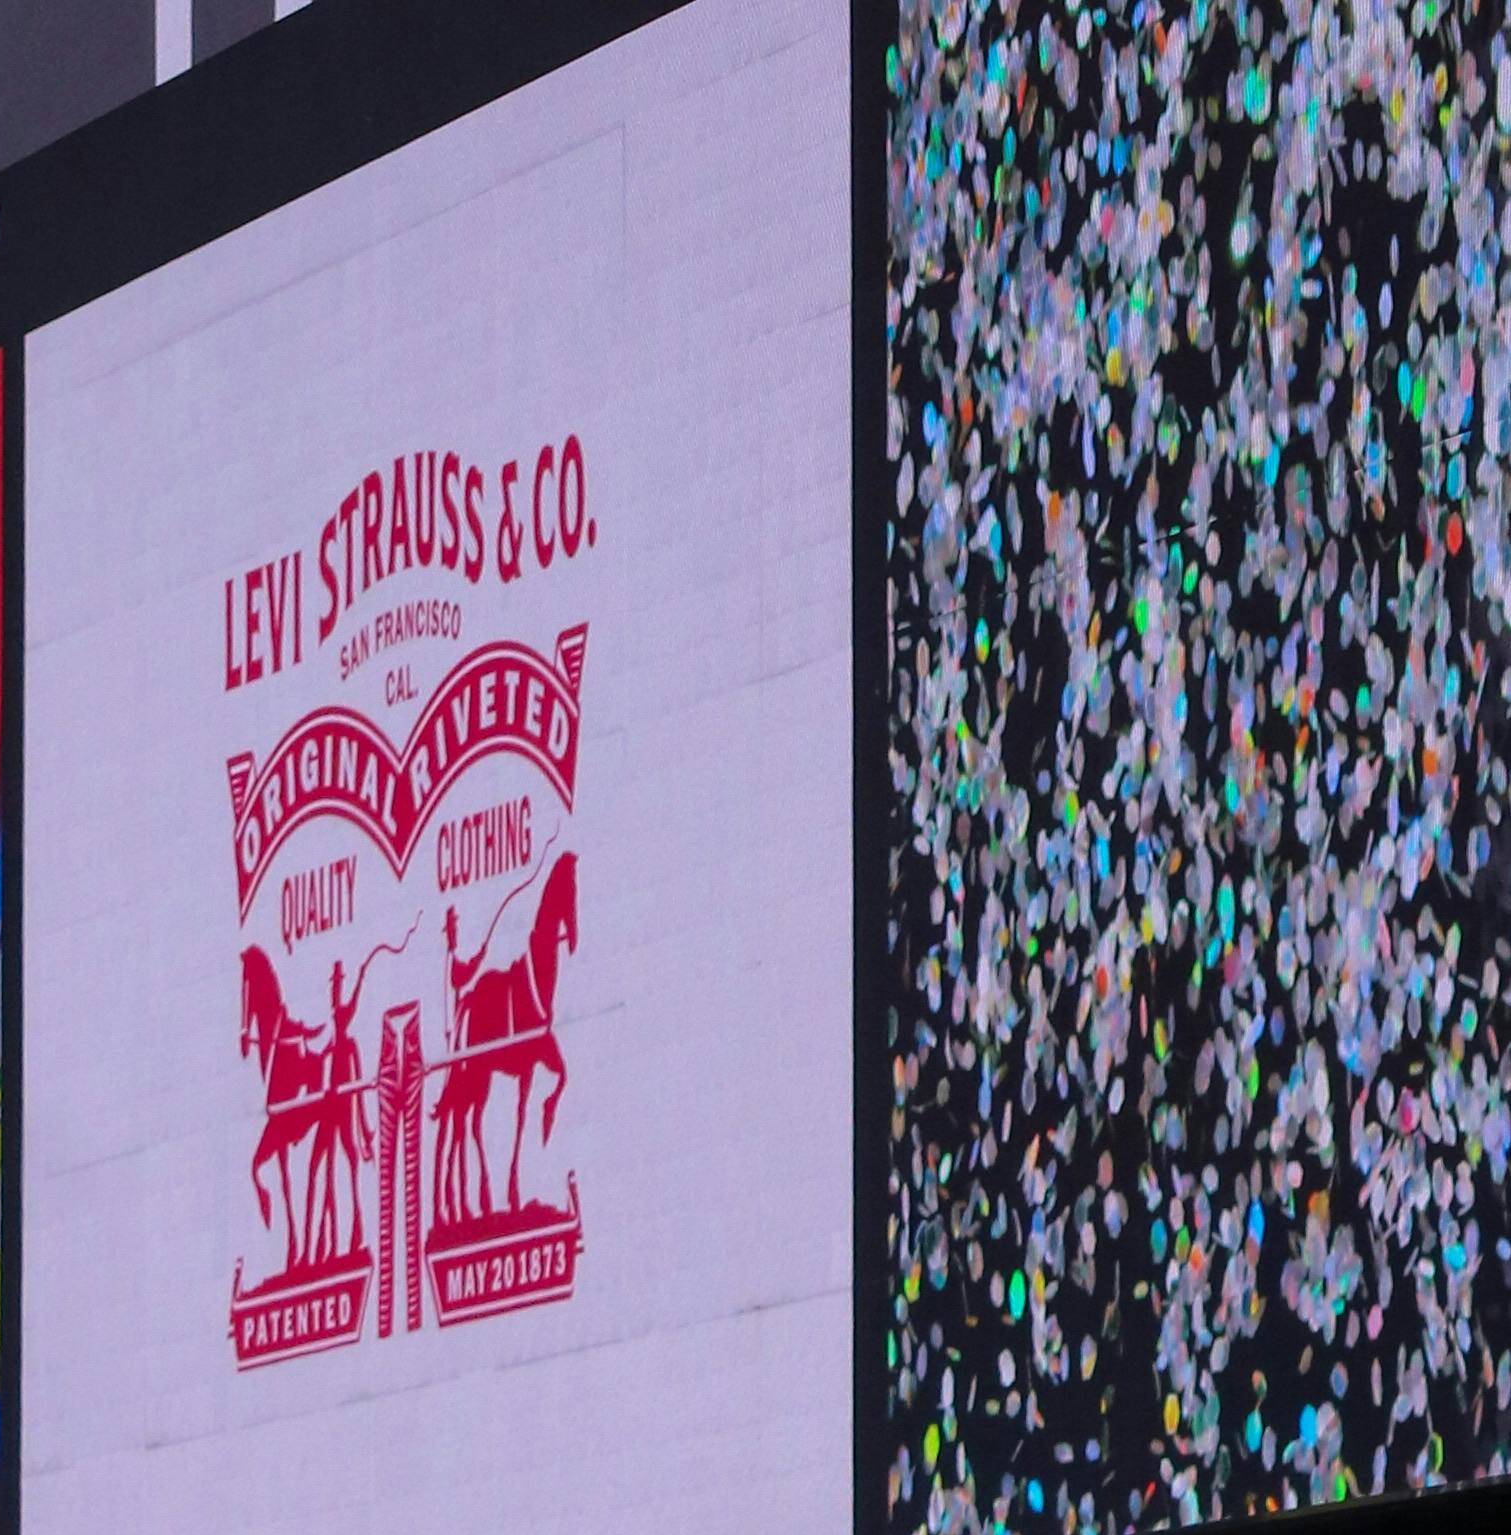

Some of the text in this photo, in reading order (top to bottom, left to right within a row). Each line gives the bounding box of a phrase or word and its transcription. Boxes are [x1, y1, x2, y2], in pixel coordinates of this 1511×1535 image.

[224, 434, 598, 692] LEVI STRAUSS & CO.
[339, 599, 462, 681] SAN FRANCISCO
[385, 664, 420, 707] CAL.
[409, 669, 570, 812] RIVETED
[238, 734, 400, 876] ORIGINAL
[436, 795, 533, 893] CLOTHING
[280, 854, 357, 956] QUALITY
[242, 1292, 352, 1350] PATENTED
[447, 1240, 567, 1304] MAY 20 1873
